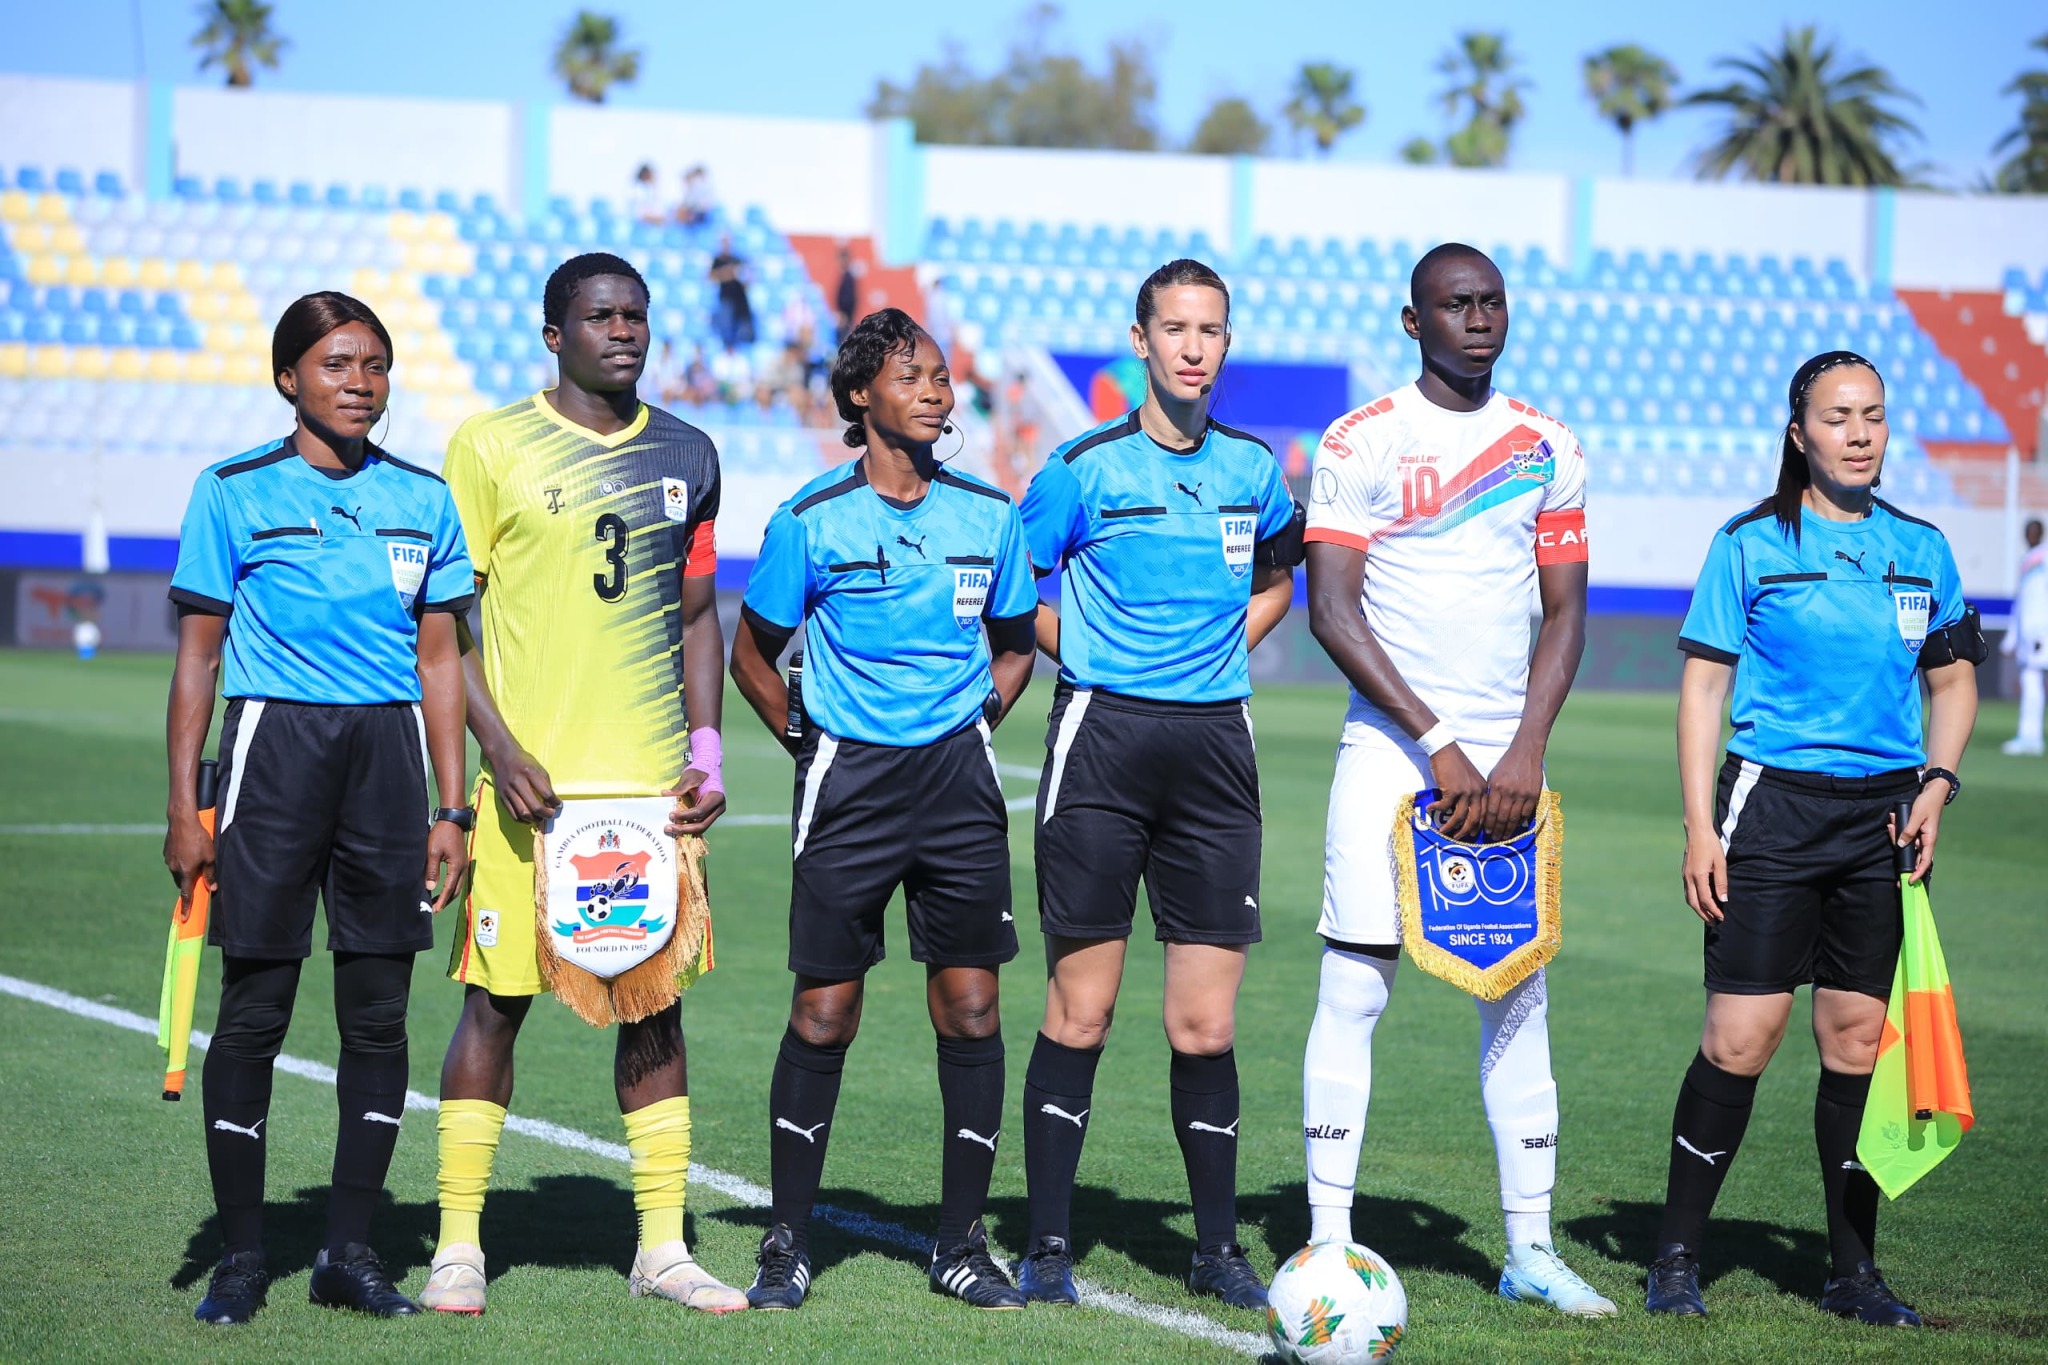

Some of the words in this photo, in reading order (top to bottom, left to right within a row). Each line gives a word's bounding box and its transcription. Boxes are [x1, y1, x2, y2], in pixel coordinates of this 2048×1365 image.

[1399, 455, 1441, 464] saller
[1398, 466, 1441, 518] 10
[1224, 520, 1252, 536] FIFA
[1226, 544, 1252, 554] REFEREE
[392, 548, 424, 565] FIFA
[593, 513, 630, 604] 3
[959, 573, 988, 588] FIFA
[956, 598, 984, 606] REFEREE
[1899, 596, 1928, 610] FIFA
[1908, 640, 1920, 648] 2025
[555, 834, 575, 868] GAMBIA
[576, 818, 622, 836] FOOTBALL
[626, 820, 668, 864] FEDERATION
[1428, 924, 1456, 932] Federation
[1449, 934, 1486, 946] SINCE
[1489, 933, 1513, 945] 1924
[576, 945, 618, 953] FOUNDED
[620, 944, 628, 952] IN
[632, 944, 647, 952] 1952
[1304, 1124, 1350, 1140] saller
